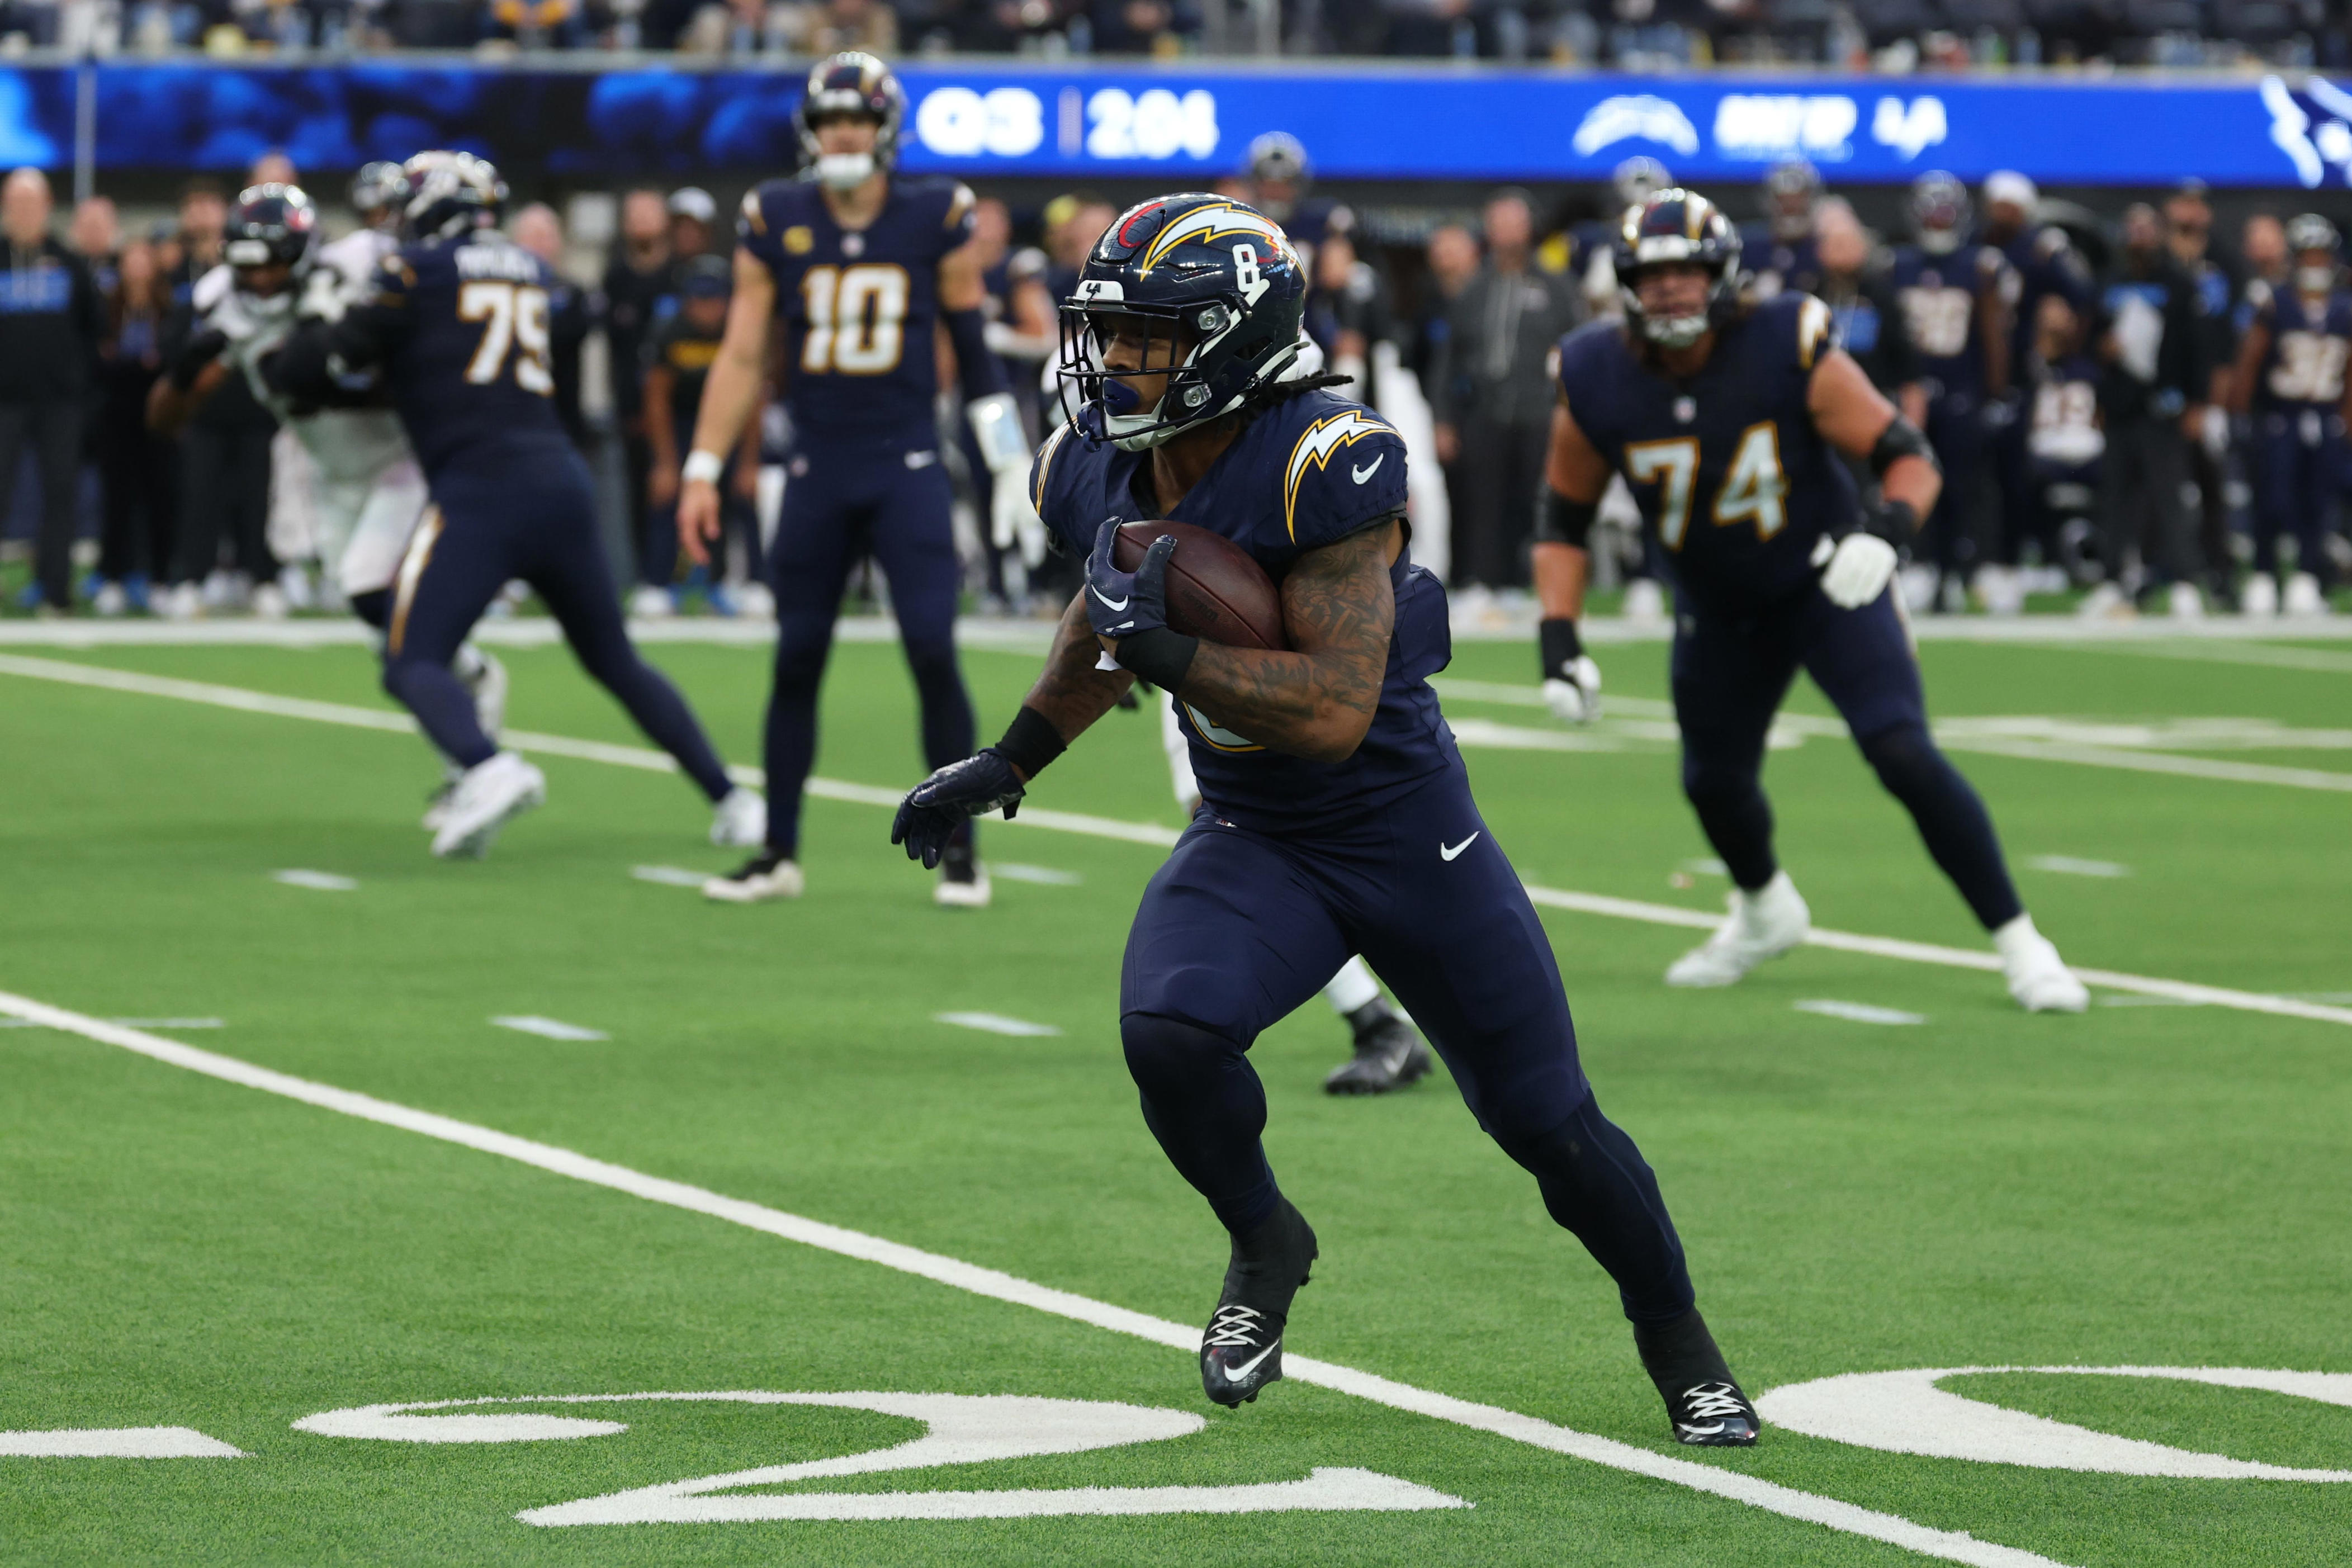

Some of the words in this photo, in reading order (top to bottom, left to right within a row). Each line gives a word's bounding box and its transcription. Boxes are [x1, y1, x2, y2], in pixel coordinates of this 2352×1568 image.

[1086, 283, 1101, 295] LA
[1232, 244, 1261, 292] 8
[799, 263, 910, 375] 10
[1624, 420, 1791, 552] 74
